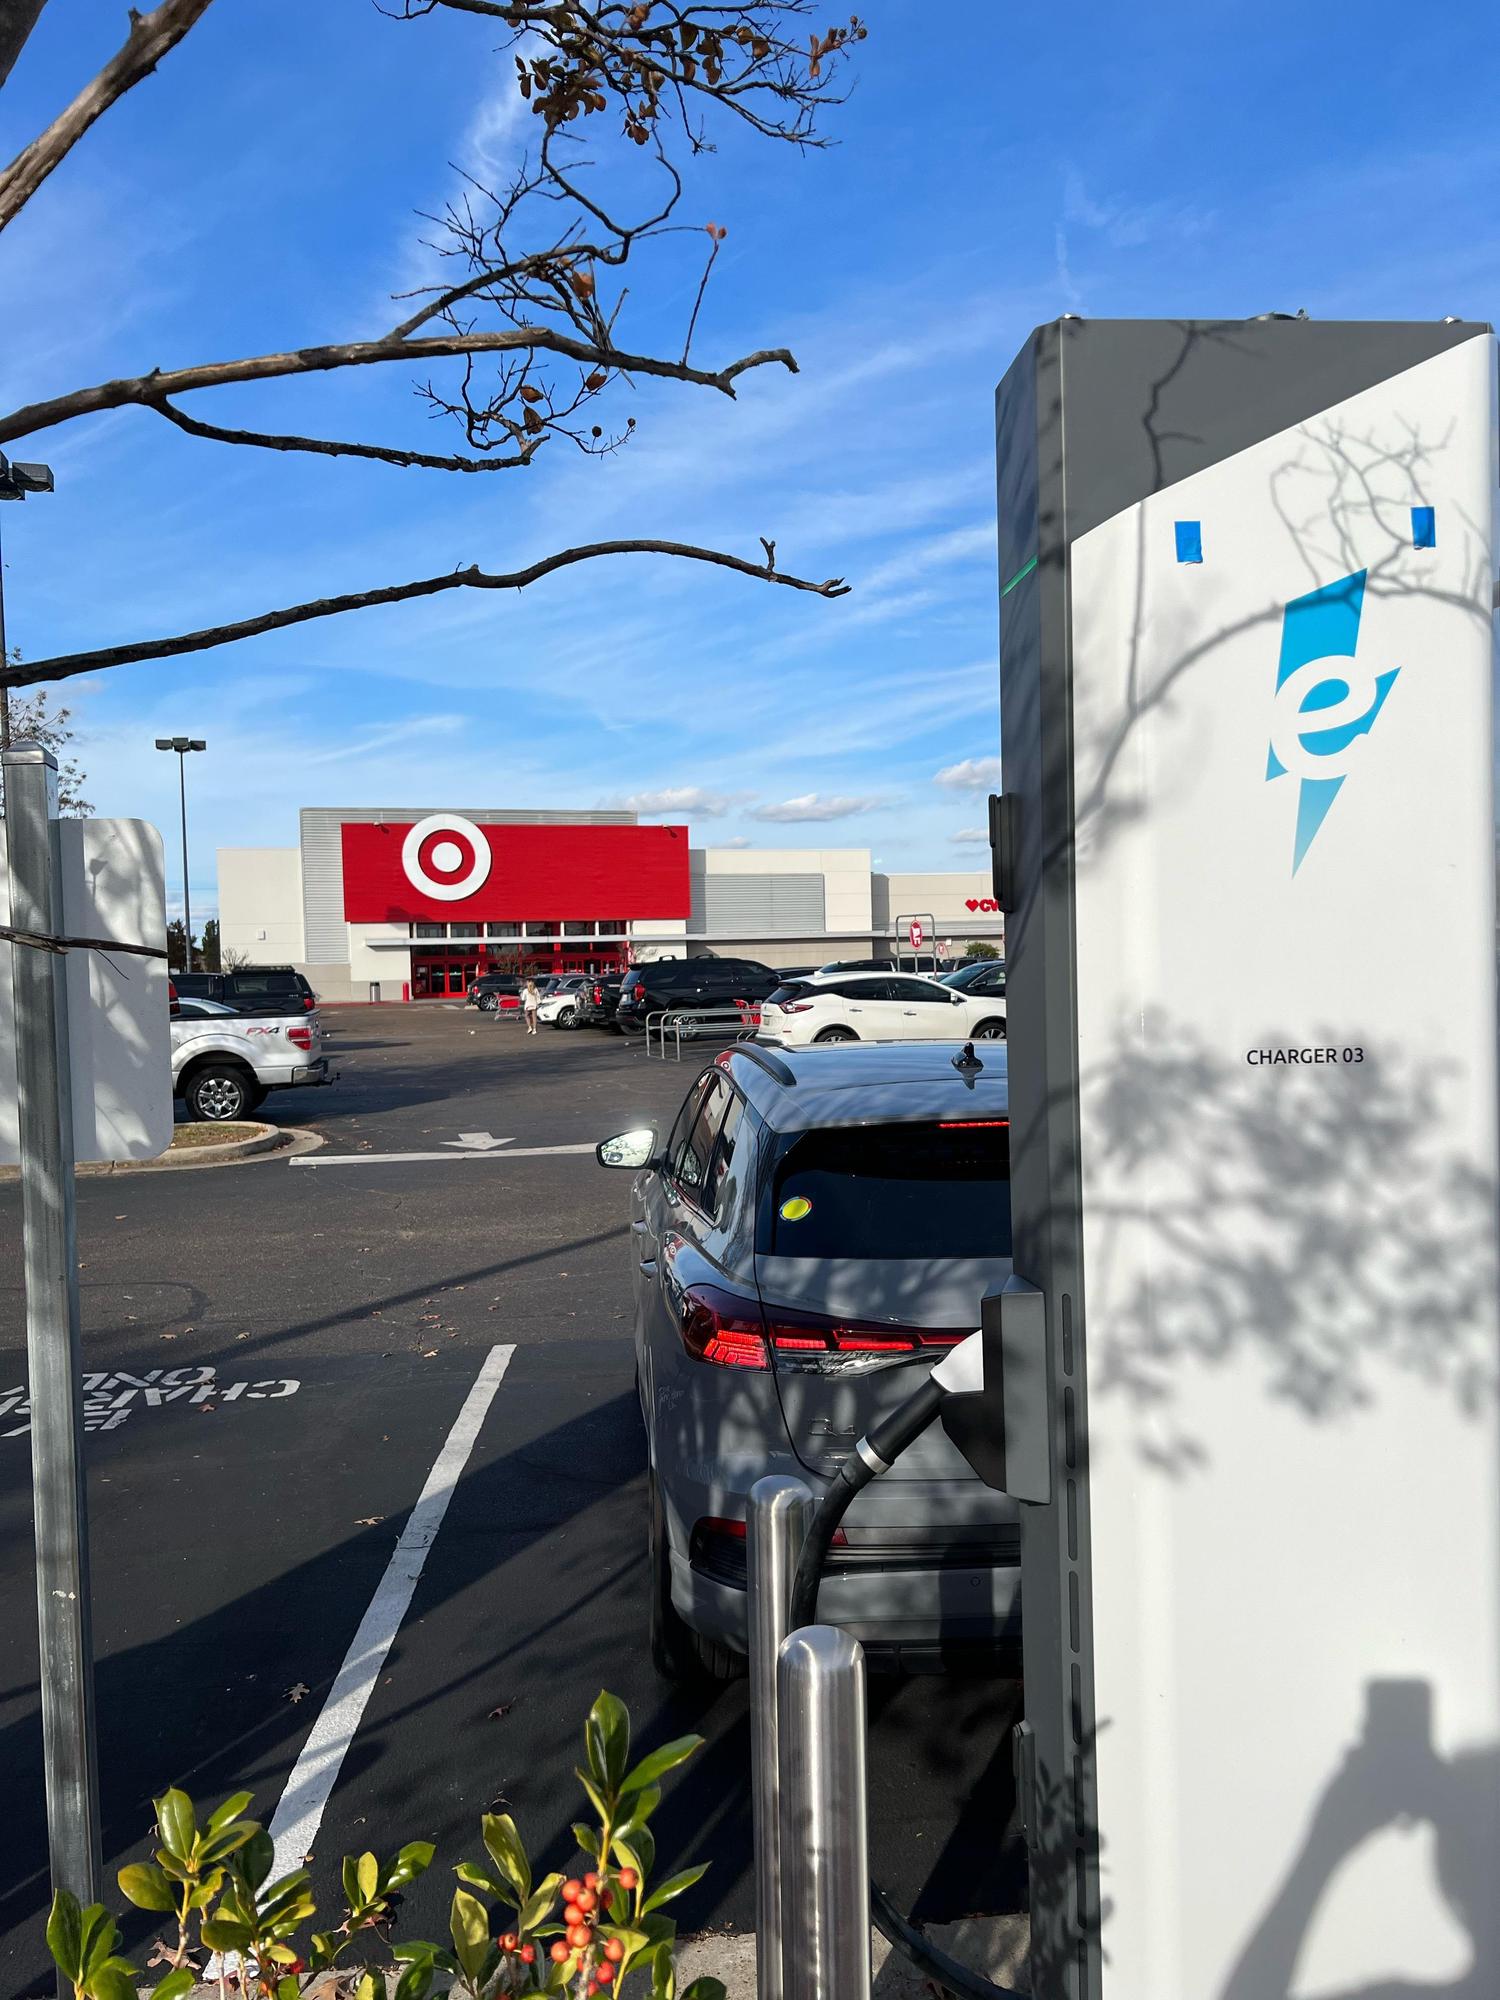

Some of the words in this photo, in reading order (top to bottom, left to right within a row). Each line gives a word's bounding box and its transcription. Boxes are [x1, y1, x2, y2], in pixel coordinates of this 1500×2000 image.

[979, 899, 999, 912] CV
[247, 1027, 280, 1035] FX4
[1247, 1048, 1338, 1065] CHARGER
[1342, 1047, 1364, 1063] 03
